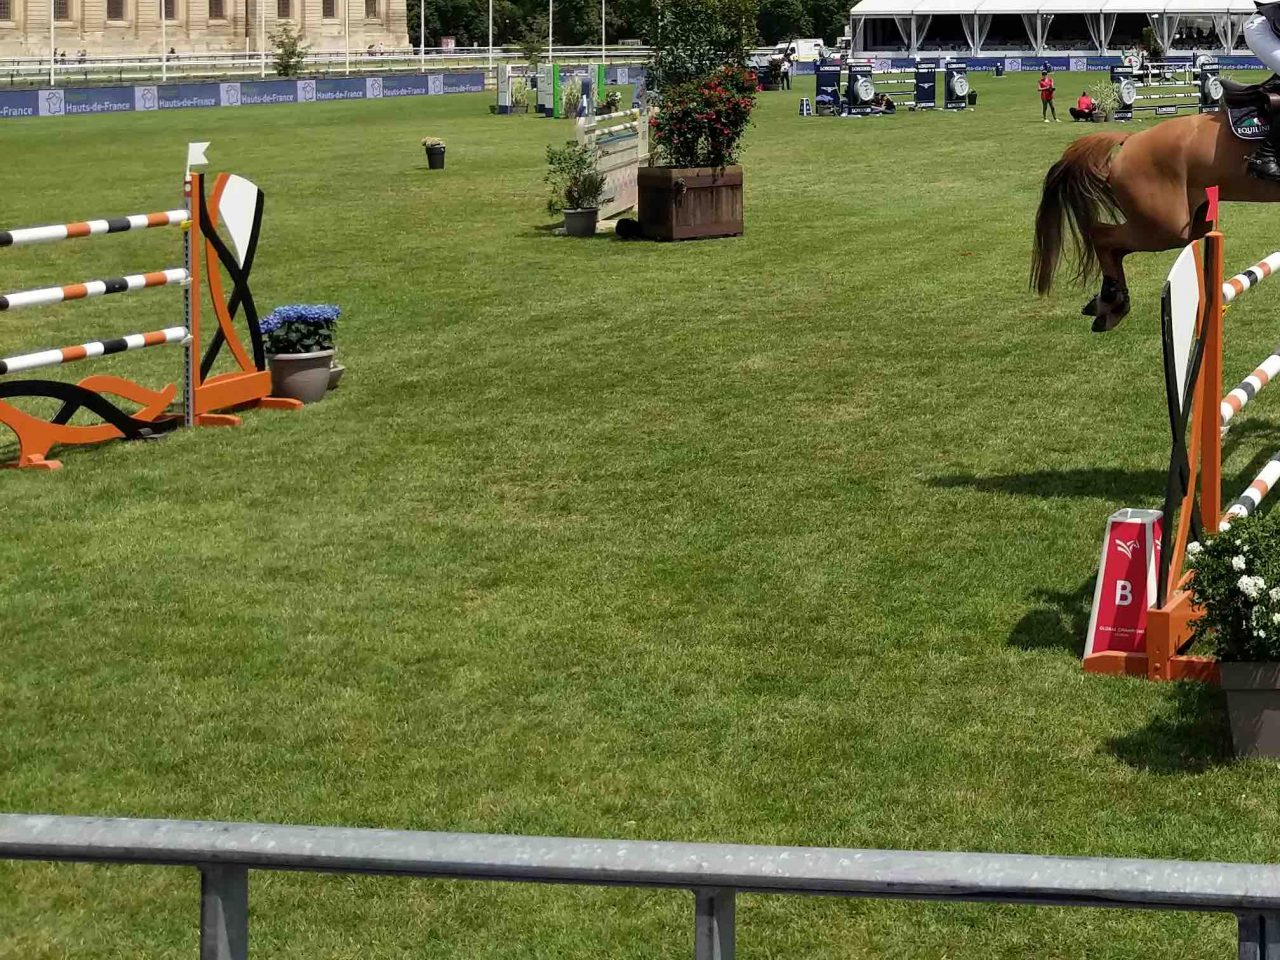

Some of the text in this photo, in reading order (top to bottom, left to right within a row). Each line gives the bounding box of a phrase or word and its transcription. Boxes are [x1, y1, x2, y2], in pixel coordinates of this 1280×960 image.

[241, 93, 294, 103] Hauts-de-France
[316, 90, 363, 100] Hauts-de-France
[66, 101, 130, 112] Hauts-de-France
[159, 97, 216, 108] Hauts-de-France
[1115, 579, 1133, 606] B
